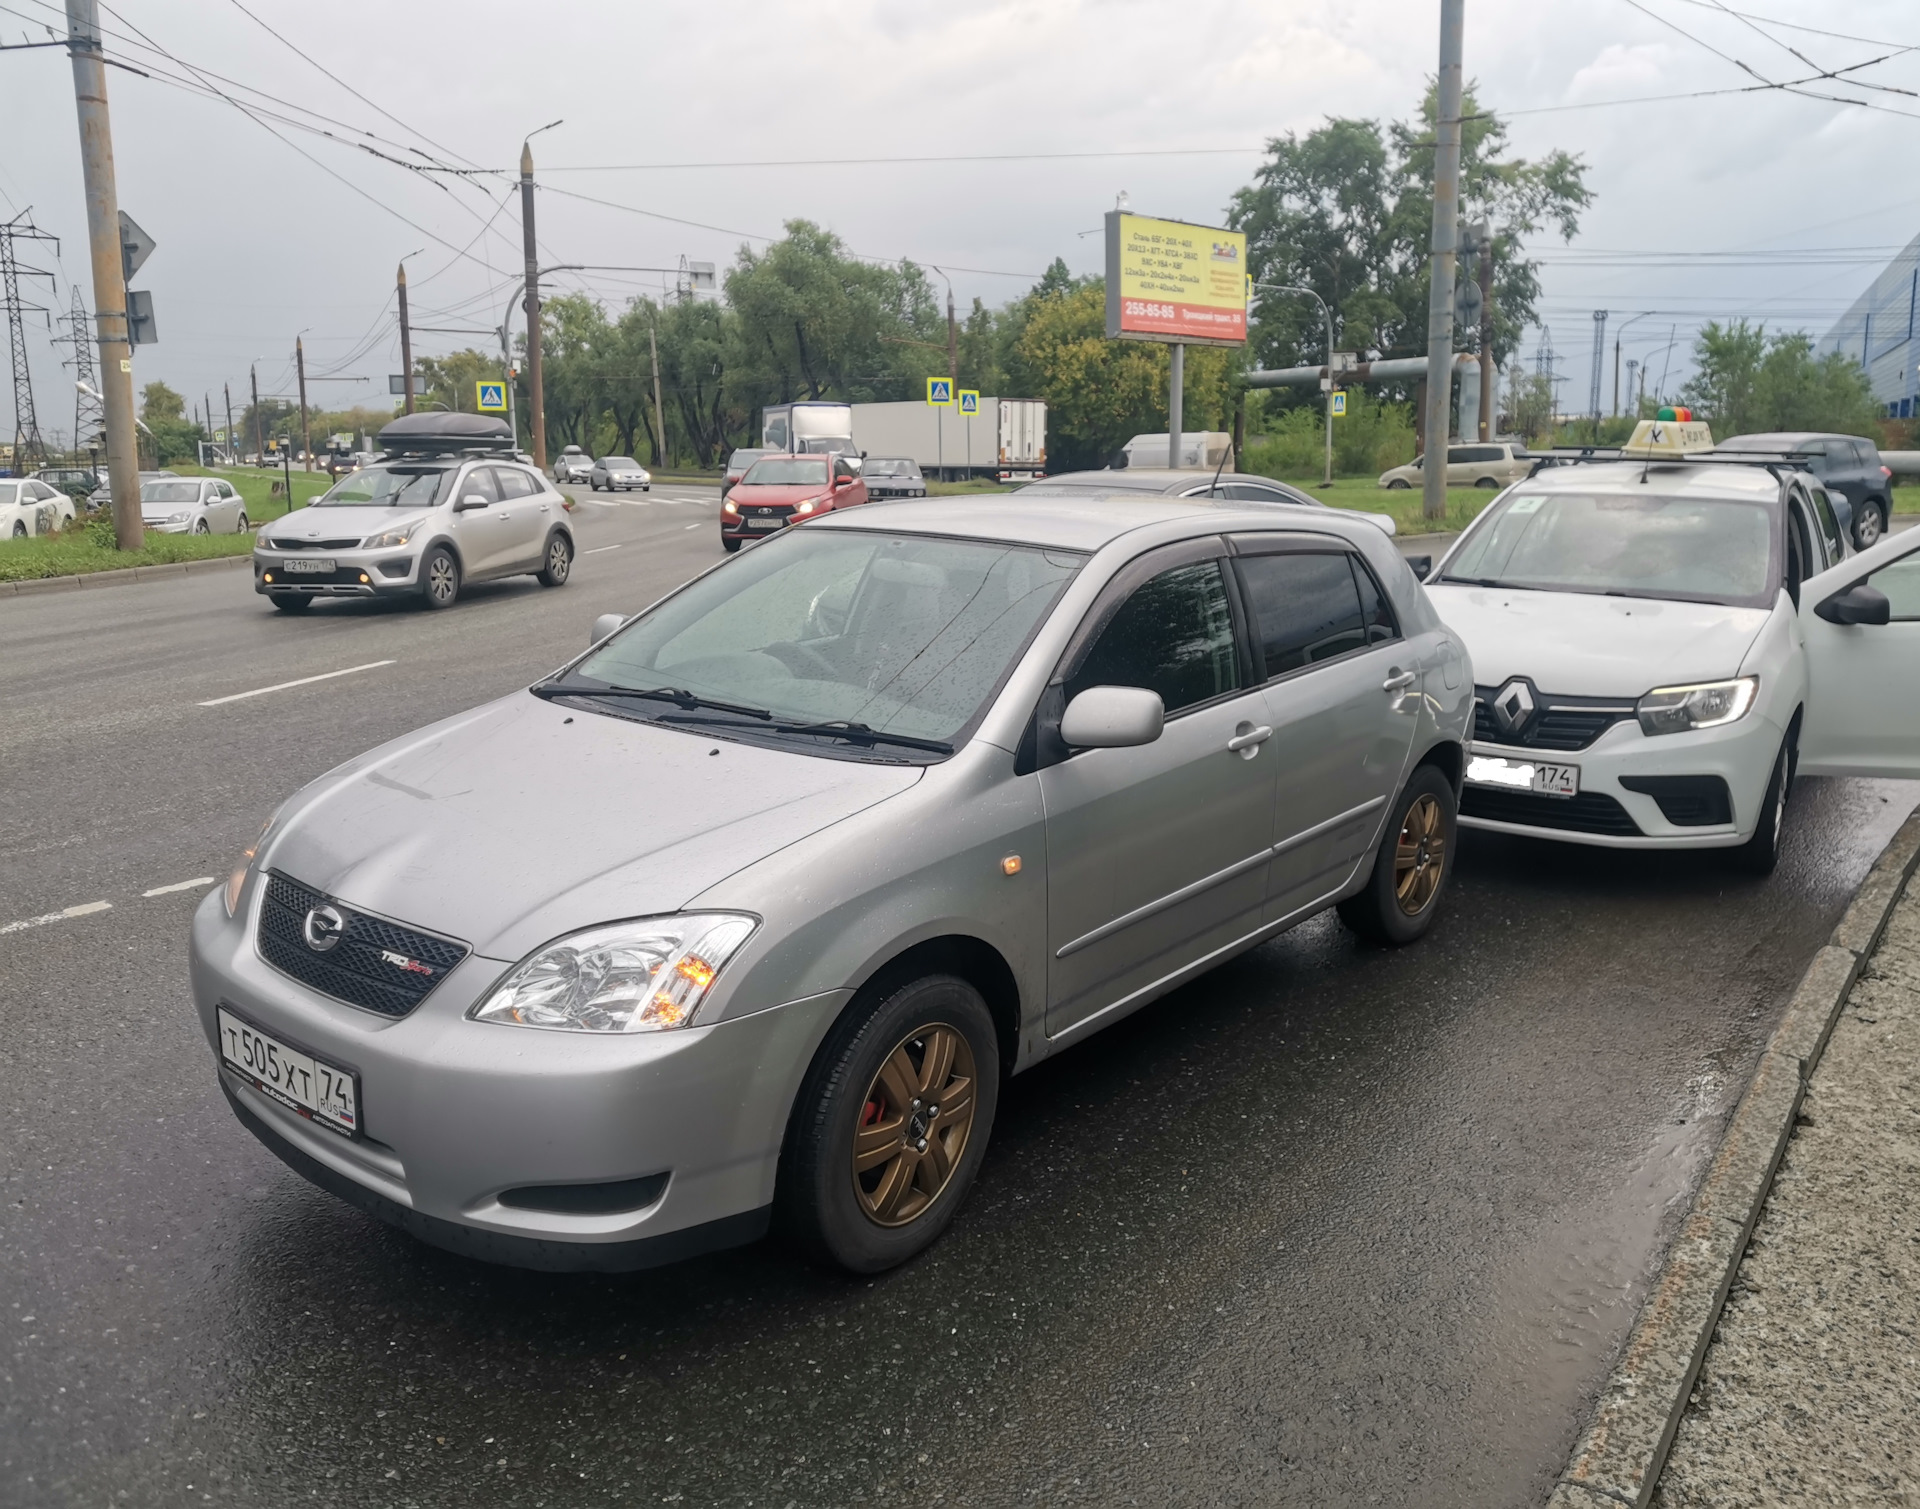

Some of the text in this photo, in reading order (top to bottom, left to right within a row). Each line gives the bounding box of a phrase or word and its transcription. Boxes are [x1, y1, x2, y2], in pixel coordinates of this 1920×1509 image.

[1133, 232, 1150, 242] Сталь
[1127, 243, 1146, 253] 20Х13
[1125, 301, 1175, 319] 255-85-85
[1537, 766, 1570, 786] 174
[1542, 783, 1560, 791] RUS
[382, 950, 409, 966] TRD
[228, 1027, 347, 1110] Т505ХТ 74
[320, 1097, 339, 1117] RUS
